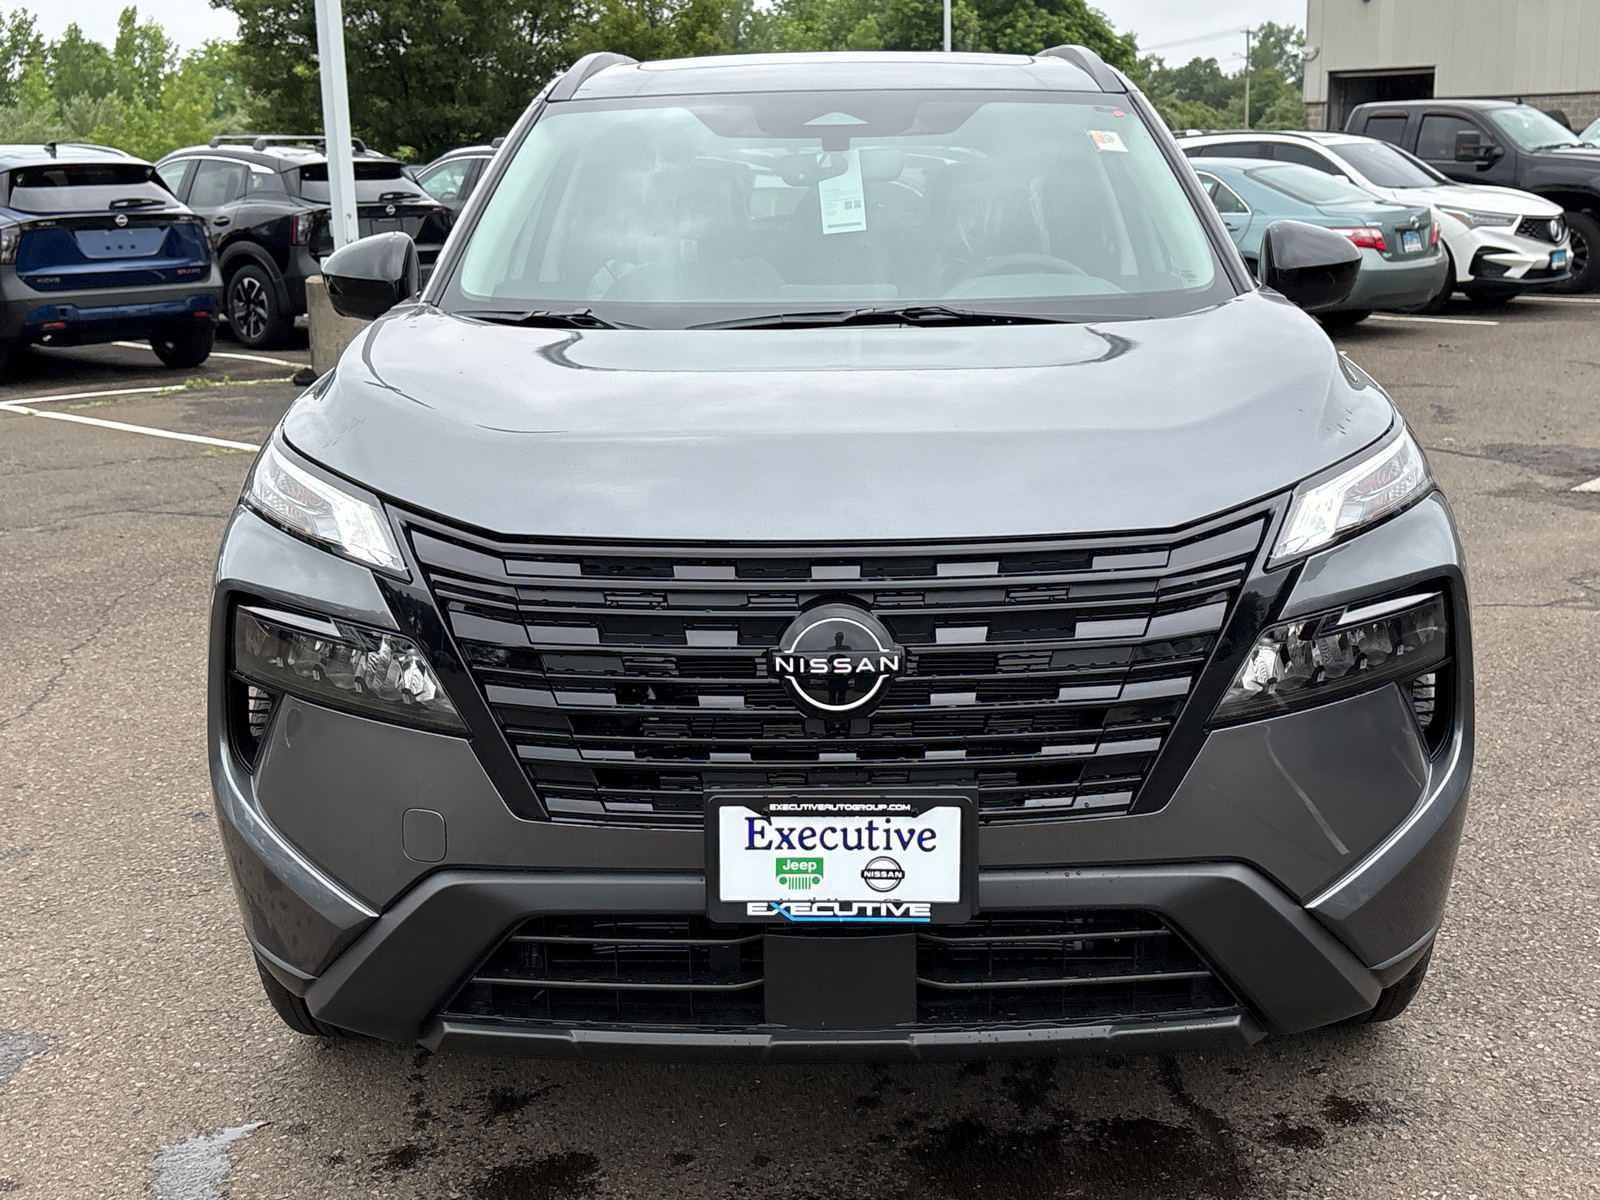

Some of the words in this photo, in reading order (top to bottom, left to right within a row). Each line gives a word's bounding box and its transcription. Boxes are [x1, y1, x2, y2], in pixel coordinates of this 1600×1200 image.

[775, 655, 899, 673] NISSAN
[769, 803, 911, 811] EXECUTIVEAUTOGROUP.COM
[744, 816, 937, 852] Executive
[782, 859, 817, 872] Jeep
[863, 870, 903, 879] NISSAN
[746, 902, 932, 918] EXECUTIVE
